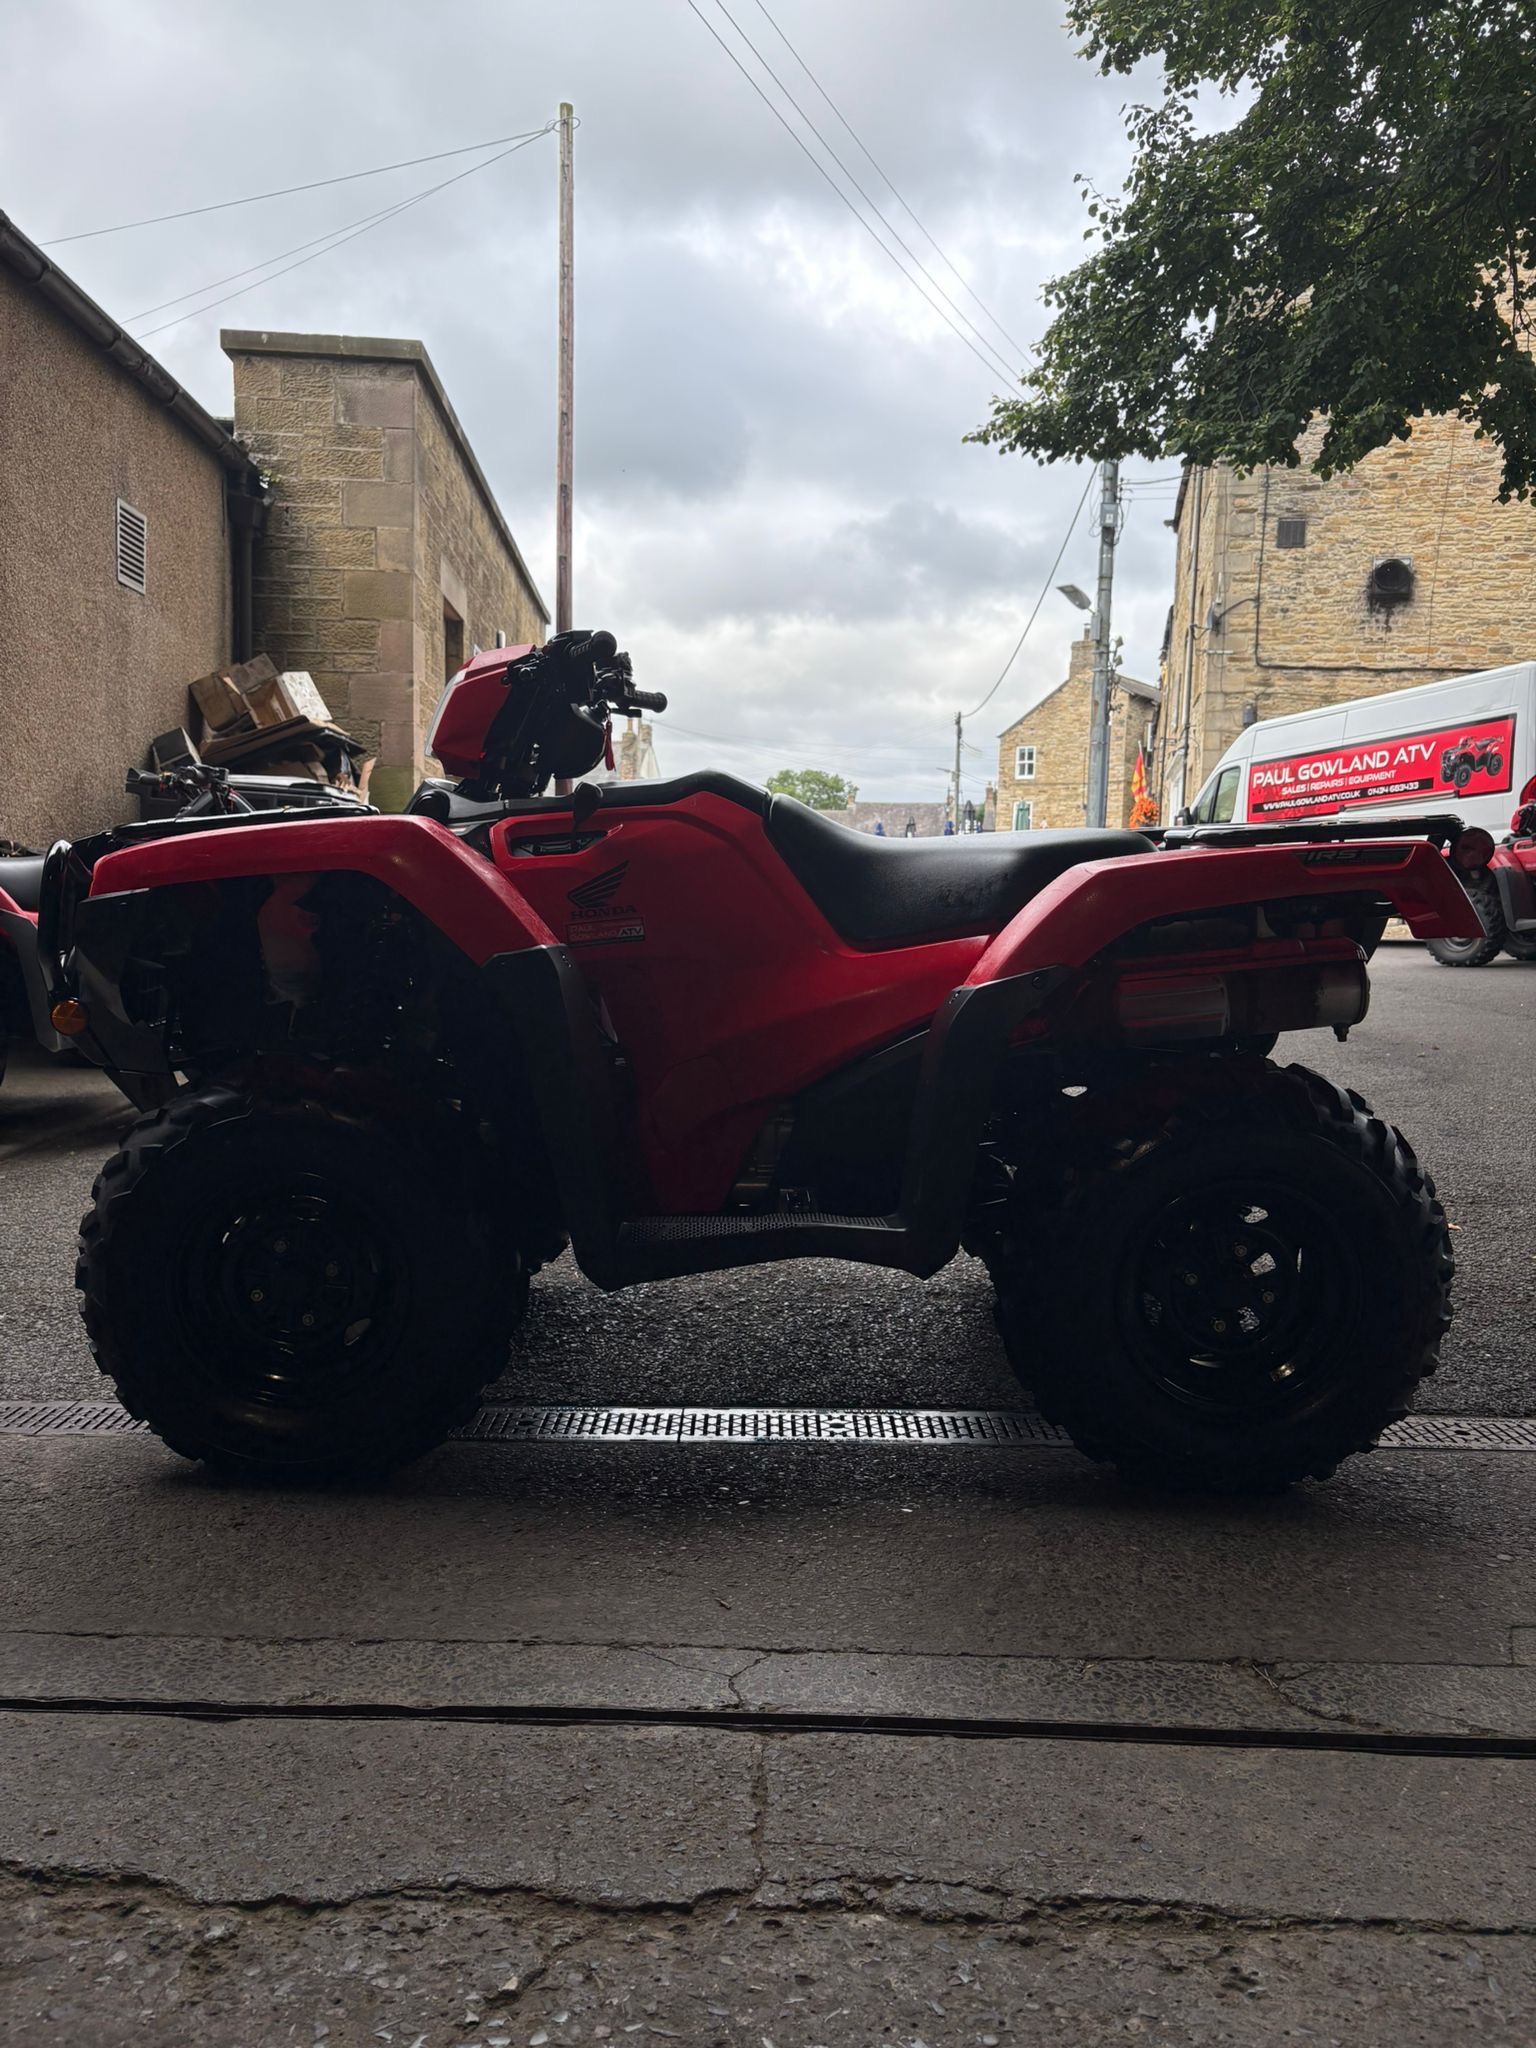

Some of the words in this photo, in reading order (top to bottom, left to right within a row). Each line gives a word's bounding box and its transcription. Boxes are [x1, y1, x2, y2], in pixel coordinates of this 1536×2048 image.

[1253, 766, 1294, 788] PAUL
[1298, 750, 1389, 780] GOWLAND
[1393, 741, 1436, 765] ATV
[1282, 784, 1307, 796] SALES
[1310, 778, 1344, 792] REPAIRS
[1348, 770, 1397, 786] EQUIPMENT
[571, 905, 637, 920] HONDA
[621, 927, 642, 936] ATV
